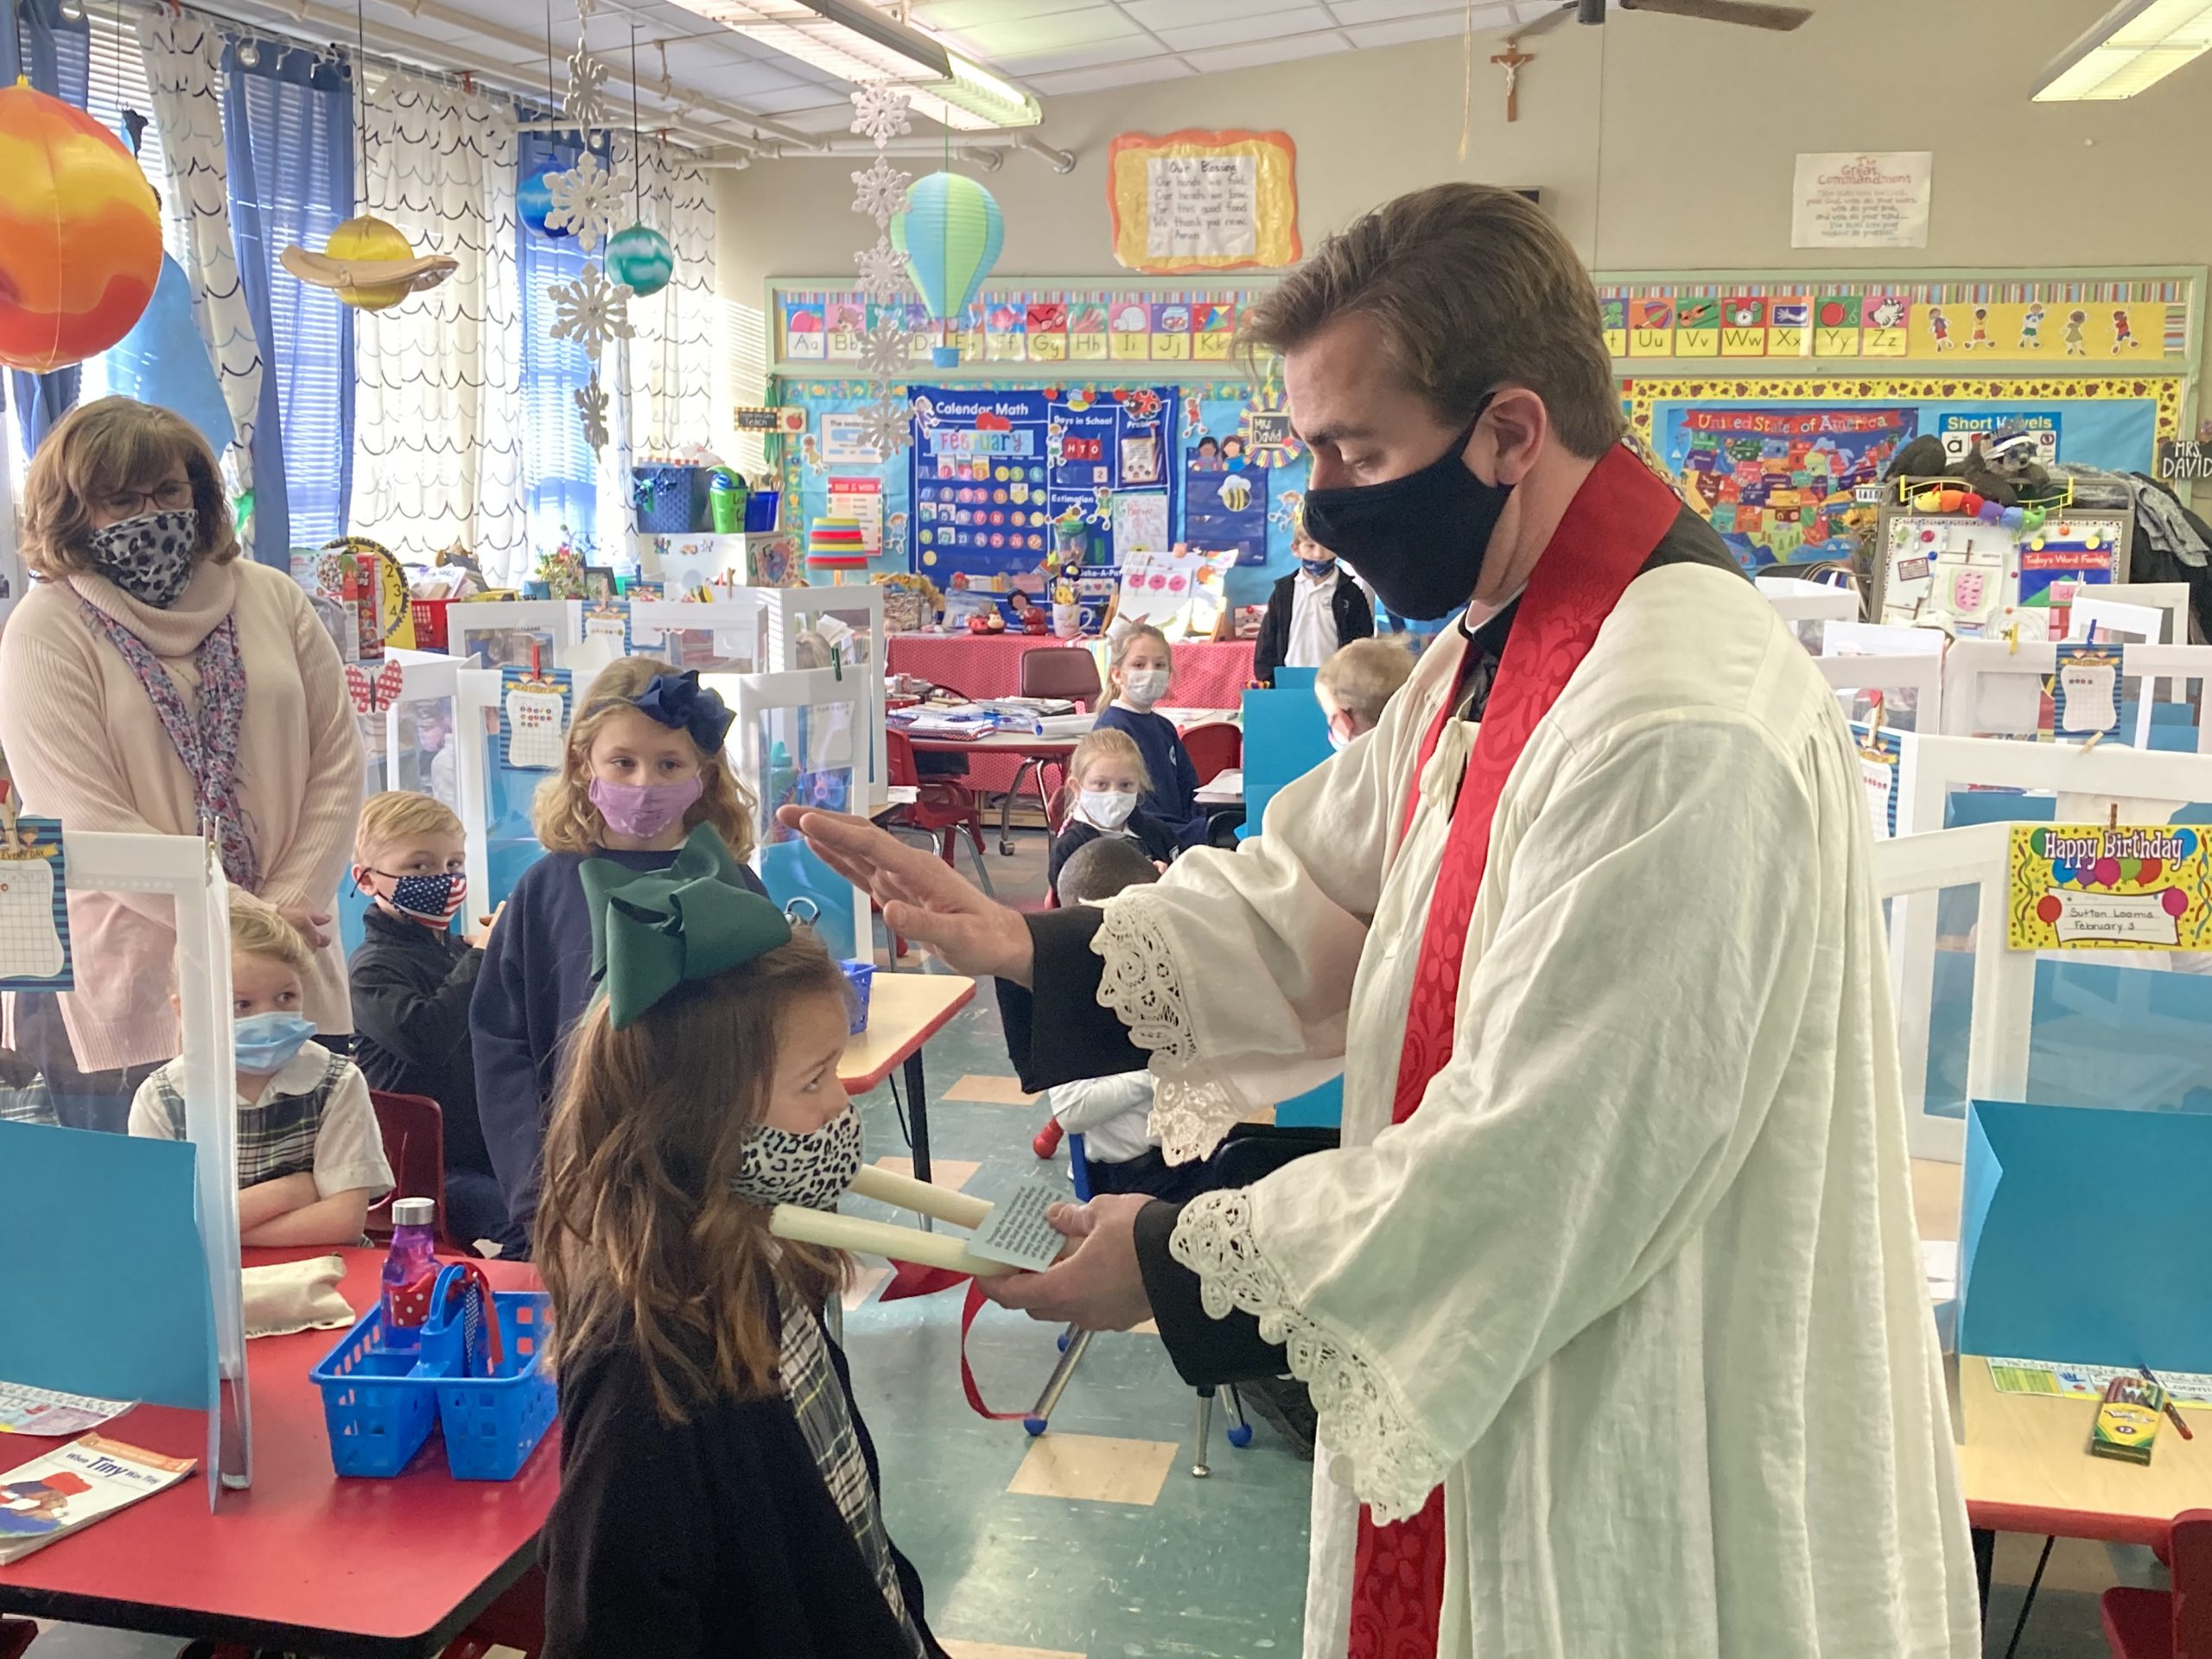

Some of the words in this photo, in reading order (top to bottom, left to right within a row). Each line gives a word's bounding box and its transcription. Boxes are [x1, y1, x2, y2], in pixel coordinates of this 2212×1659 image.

[1856, 156, 1877, 167] The
[1170, 162, 1191, 174] Our
[1841, 165, 1878, 176] Great
[1155, 177, 1171, 187] Our
[1177, 176, 1201, 187] hands
[1818, 175, 1911, 185] Commandment
[1154, 189, 1173, 200] Our
[1155, 204, 1169, 213] For
[1176, 203, 1196, 213] this
[1201, 203, 1222, 215] good
[1154, 218, 1167, 228] We
[1174, 217, 1201, 227] thank
[794, 335, 818, 350] Aa
[835, 334, 859, 351] Bb
[1033, 335, 1059, 358] Gg
[1077, 335, 1100, 351] Hh
[1122, 335, 1135, 351] Ii
[1159, 335, 1180, 358] Jj
[1638, 329, 1663, 347] Uu
[1686, 329, 1708, 346] Vv
[1724, 329, 1762, 346] Ww
[1777, 329, 1802, 346] Xx
[1825, 329, 1849, 353] Yy
[1872, 329, 1897, 347] Zz
[936, 401, 993, 415] Calendar
[995, 402, 1029, 416] Math
[745, 418, 767, 427] Teach
[1053, 415, 1073, 425] Days
[1085, 416, 1113, 426] School
[1800, 417, 1816, 433] of
[1948, 416, 1993, 429] Short
[1254, 429, 1281, 444] David
[939, 432, 1022, 455] February
[1068, 444, 1075, 453] H
[1080, 444, 1086, 453] T
[1090, 444, 1099, 454] O
[2163, 454, 2212, 478] DAVID
[1097, 470, 1103, 479] 2
[1052, 493, 1094, 503] Estimation
[958, 535, 968, 543] 23
[2024, 555, 2054, 567] Today's
[2056, 555, 2079, 564] Word
[2081, 555, 2107, 566] Family
[385, 565, 394, 577] 2
[394, 584, 402, 597] 3
[390, 606, 398, 617] 4
[2044, 831, 2099, 870] Happy
[2103, 830, 2183, 872] Birthday
[2069, 907, 2107, 918] Sutton
[2113, 907, 2154, 918] Loomis
[2075, 920, 2124, 934] February
[2127, 921, 2135, 931] 3
[86, 1456, 130, 1478] Tiny
